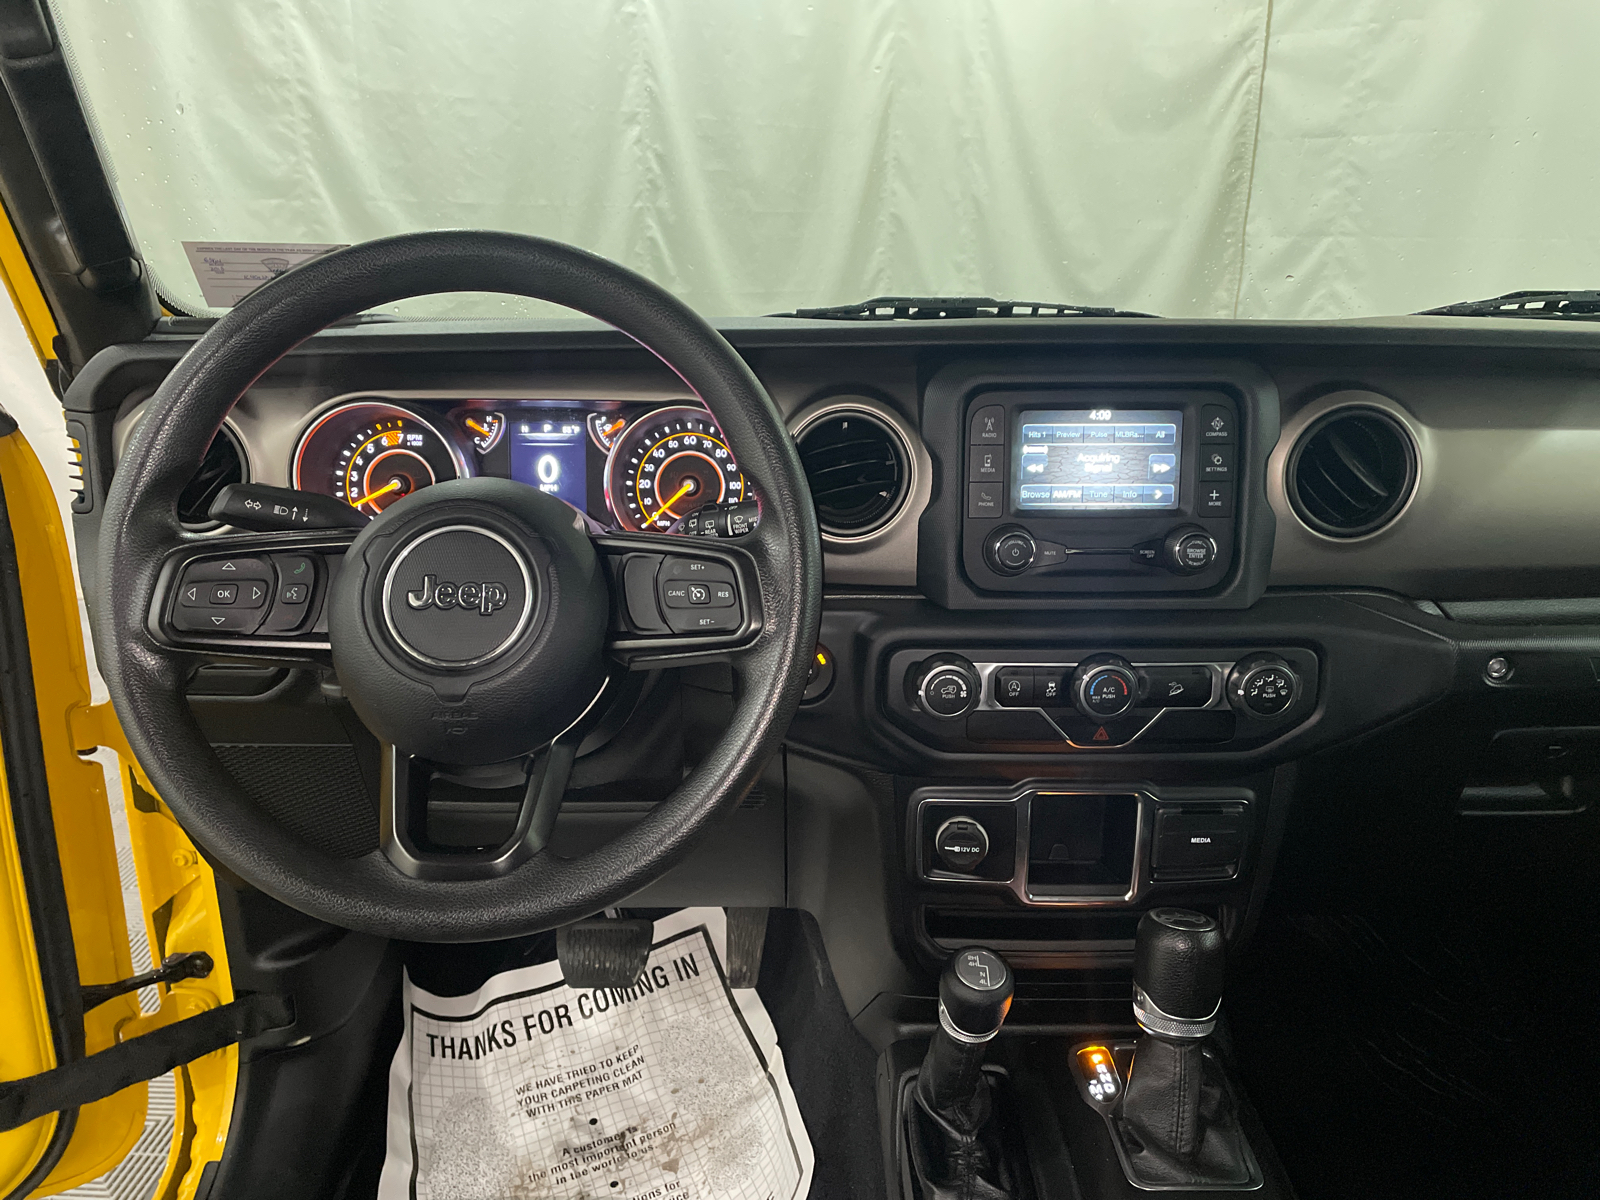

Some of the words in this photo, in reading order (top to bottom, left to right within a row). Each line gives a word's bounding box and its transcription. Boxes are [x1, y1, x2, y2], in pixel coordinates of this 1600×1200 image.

[381, 436, 388, 446] 6
[397, 434, 404, 444] 7
[668, 440, 679, 448] 50
[684, 436, 697, 445] 60
[703, 440, 712, 448] 70
[366, 443, 375, 454] 5
[652, 449, 665, 458] 40
[715, 449, 728, 458] 80
[356, 456, 364, 466] 4
[1077, 453, 1120, 464] Acquiring
[538, 455, 559, 484] 0
[644, 464, 655, 472] 30
[726, 464, 737, 472] 90
[350, 471, 358, 482] 3
[540, 484, 558, 492] MPH
[639, 480, 651, 488] 20
[729, 482, 741, 490] 100
[350, 487, 358, 498] 2
[1053, 490, 1081, 498] AM/FM
[218, 590, 230, 598] OK
[408, 574, 508, 616] Jeep
[426, 1020, 517, 1060] THANKS
[522, 1004, 573, 1041] FOR
[673, 952, 700, 982] IN
[516, 1082, 533, 1096] WE
[535, 1073, 563, 1089] HAVE
[565, 1064, 597, 1080] TRIED
[599, 1058, 613, 1070] TO
[615, 1044, 640, 1064] KEEP
[1096, 1064, 1108, 1074] R
[517, 1092, 548, 1107] YOUR
[551, 1072, 610, 1098] CARPETING
[613, 1055, 645, 1078] CLEAN
[1100, 1072, 1112, 1083] N
[1089, 1084, 1104, 1094] M
[1103, 1083, 1116, 1094] D
[526, 1103, 556, 1118] WITH
[559, 1093, 583, 1109] THIS
[585, 1082, 620, 1100] PAPER
[622, 1070, 644, 1088] MAT
[528, 1170, 547, 1183] the
[550, 1157, 579, 1175] most
[582, 1138, 637, 1164] important
[639, 1122, 676, 1145] person
[562, 1148, 571, 1157] A
[556, 1176, 567, 1185] in
[641, 1144, 658, 1154] us.
[664, 1180, 681, 1192] for
